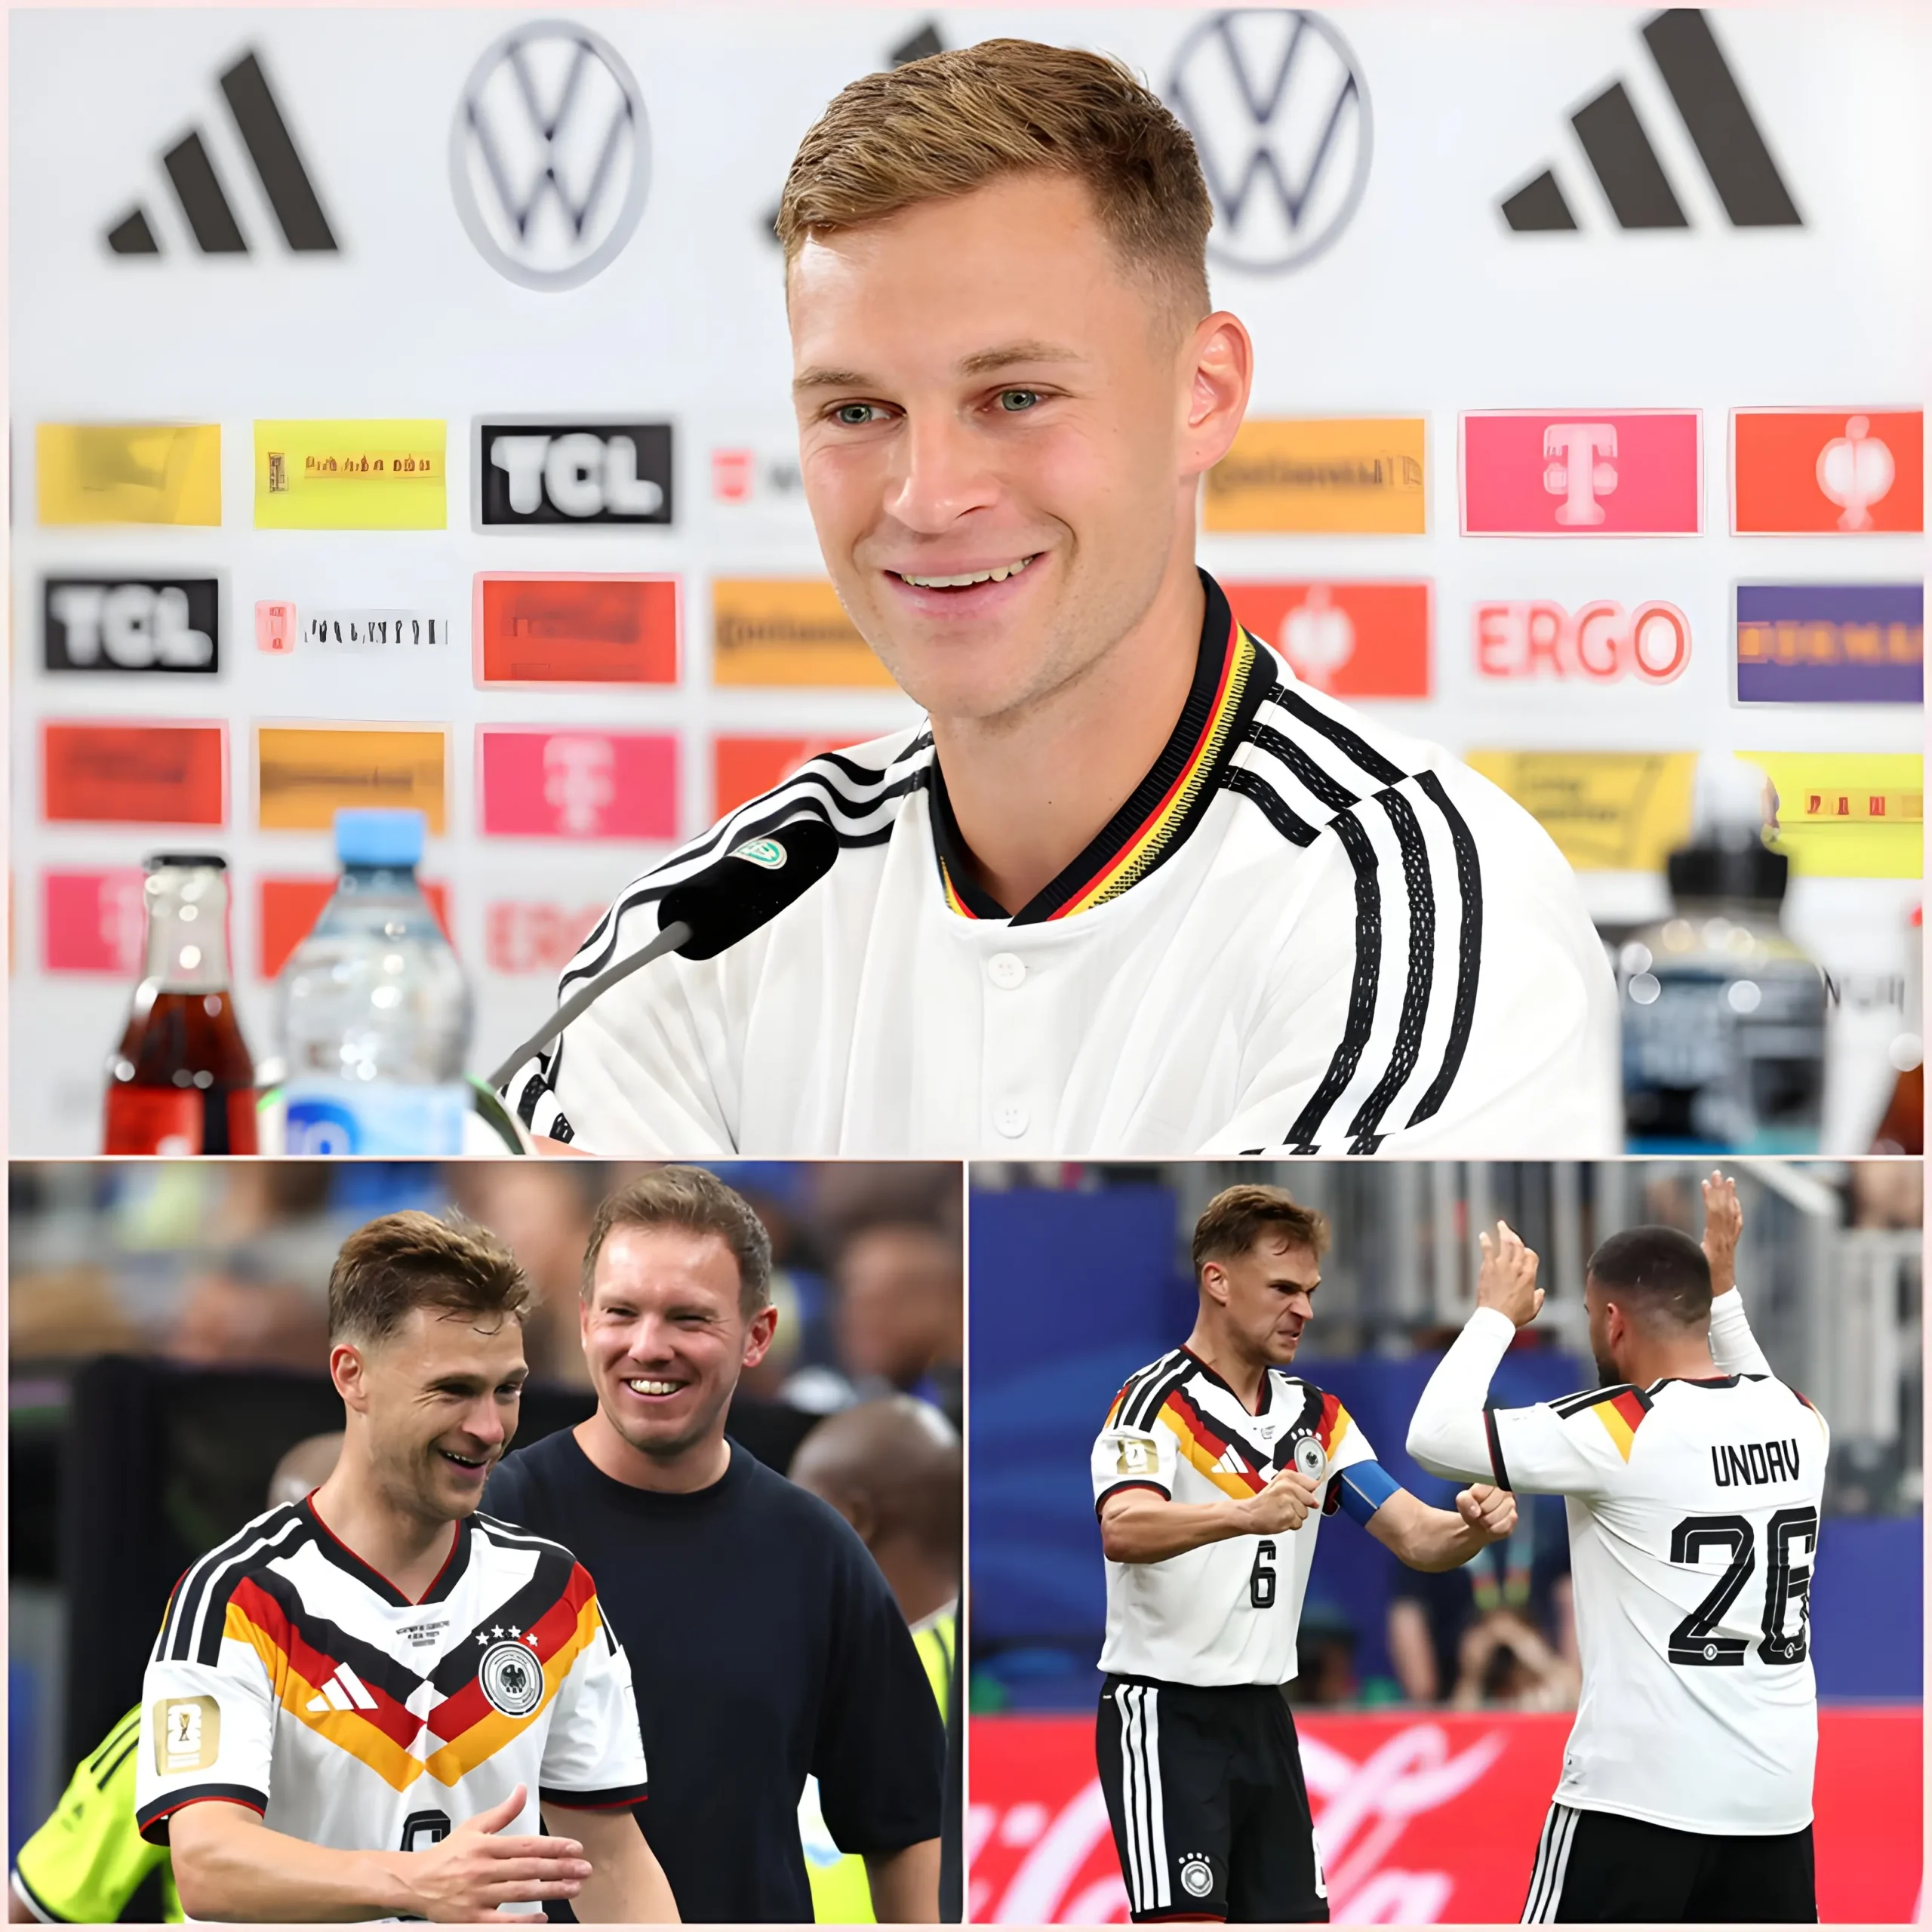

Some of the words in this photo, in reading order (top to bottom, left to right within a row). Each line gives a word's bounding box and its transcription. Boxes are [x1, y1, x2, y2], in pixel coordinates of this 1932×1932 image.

[491, 432, 663, 517] TCL
[49, 584, 213, 667] TCL
[1475, 602, 1689, 682] ERGO
[1711, 1438, 1800, 1487] UNDAV
[1250, 1540, 1277, 1609] 6
[1668, 1506, 1817, 1666] 26
